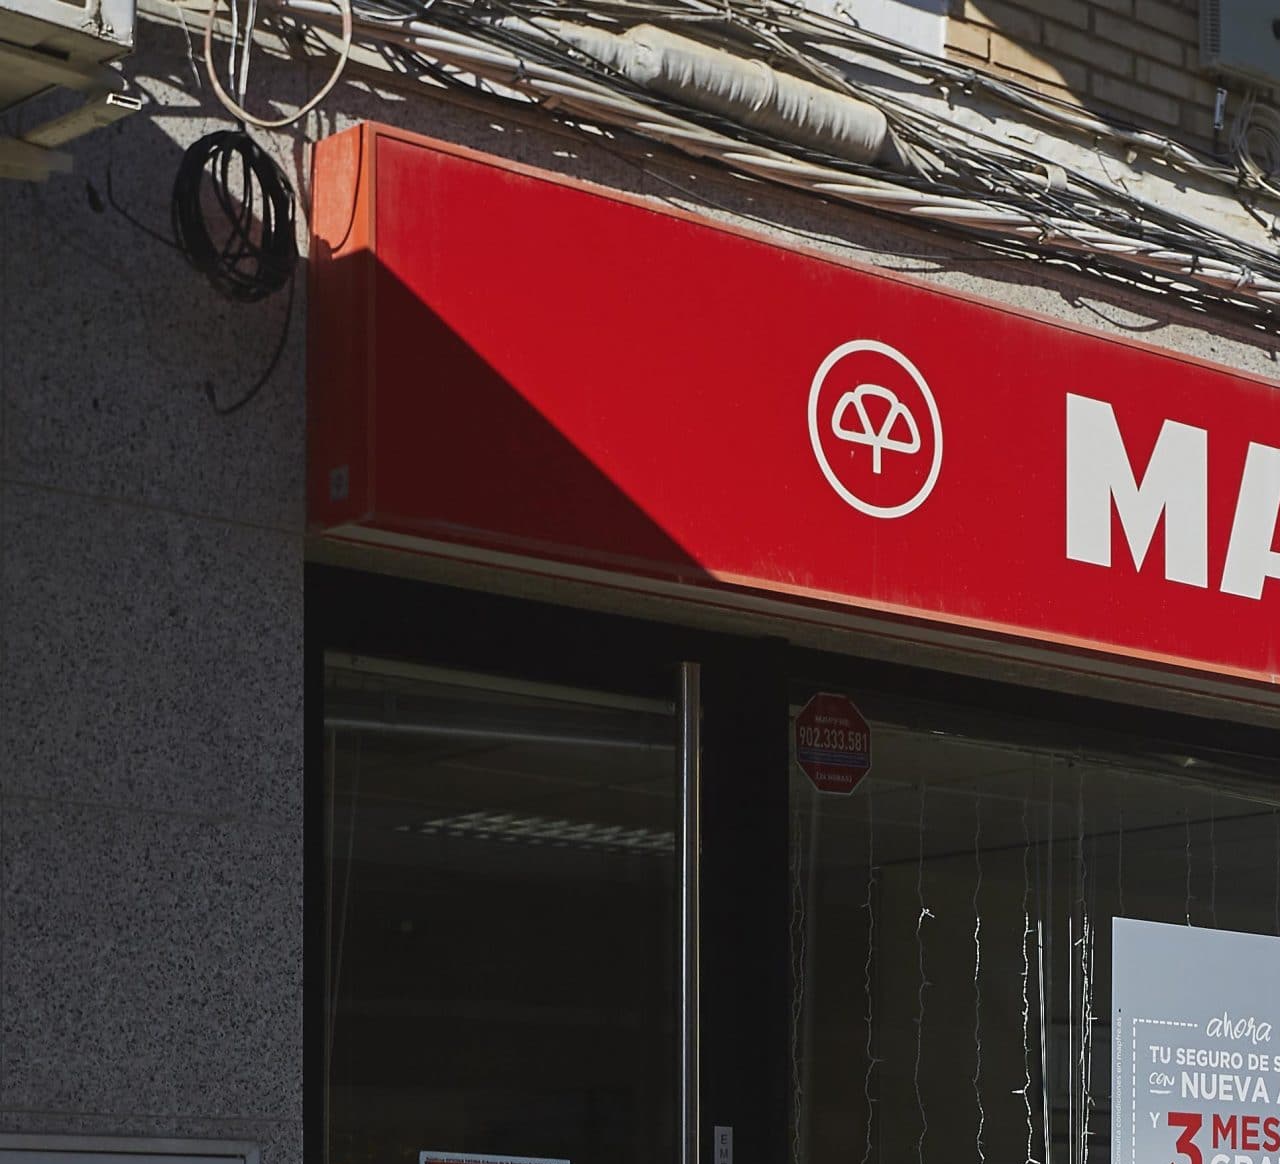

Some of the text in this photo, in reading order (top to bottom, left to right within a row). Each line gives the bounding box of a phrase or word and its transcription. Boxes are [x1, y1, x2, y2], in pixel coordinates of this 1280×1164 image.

[800, 727, 867, 752] 902.333.581
[1206, 1011, 1272, 1044] ahora
[1149, 1046, 1171, 1064] TU
[1176, 1047, 1243, 1070] SEGURO
[1248, 1053, 1269, 1072] DE
[1181, 1072, 1270, 1103] NUEVA
[1149, 1111, 1160, 1129] Y
